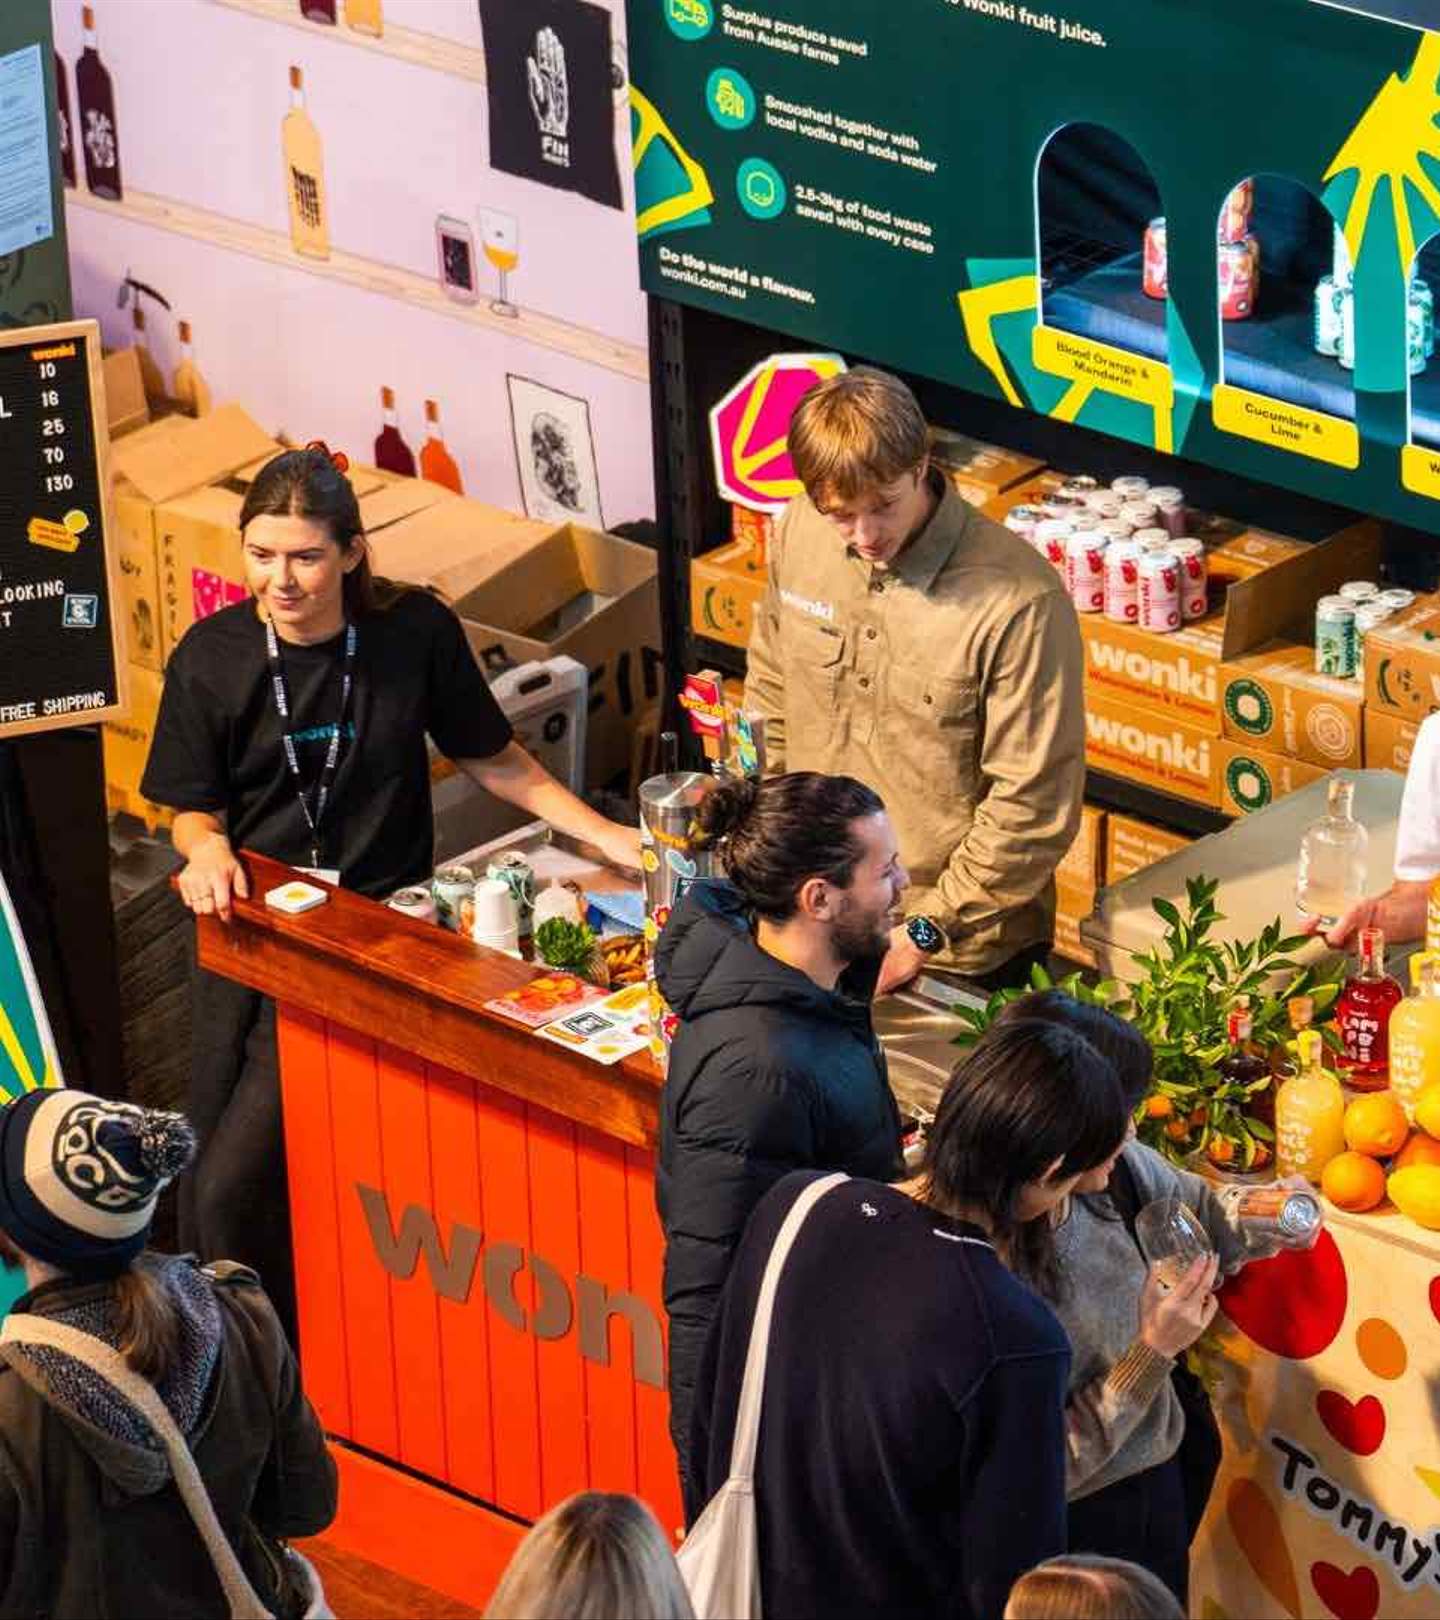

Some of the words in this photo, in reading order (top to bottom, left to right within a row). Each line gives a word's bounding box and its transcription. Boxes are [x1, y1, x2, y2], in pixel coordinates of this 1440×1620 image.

[721, 3, 773, 30] Surplus
[773, 20, 828, 45] produce
[829, 36, 868, 56] saved
[722, 20, 755, 41] from
[756, 31, 800, 53] Aussie
[801, 43, 840, 65] farms
[1019, 7, 1057, 33] fruit
[1059, 19, 1107, 47] juice.
[765, 111, 797, 132] local
[799, 122, 838, 144] vodka
[839, 135, 865, 151] and
[867, 143, 899, 162] soda
[900, 154, 938, 173] water
[834, 114, 889, 142] together
[890, 132, 920, 151] with
[794, 184, 844, 213] 2.5-3kg
[845, 201, 860, 215] of
[861, 204, 891, 224] food
[893, 216, 932, 237] waste
[795, 203, 834, 223] saved
[836, 215, 865, 233] with
[866, 224, 901, 247] every
[902, 236, 935, 254] case
[659, 246, 680, 264] Do
[682, 253, 707, 272] the
[708, 263, 749, 284] world
[750, 276, 761, 287] a
[762, 276, 816, 305] flavour.
[660, 265, 748, 300] wonki.com.au
[39, 363, 56, 379] 10
[1093, 352, 1137, 376] Orange
[42, 418, 65, 436] 25
[1244, 402, 1310, 429] Cucumber
[1313, 422, 1324, 435] &
[1271, 424, 1301, 440] Lime
[44, 447, 65, 465] 70
[46, 474, 73, 493] 130
[1089, 640, 1218, 704] wonki
[1, 701, 36, 722] FREE
[43, 690, 106, 716] SHIPPING
[1085, 712, 1211, 779] wonki
[354, 1181, 667, 1390] won
